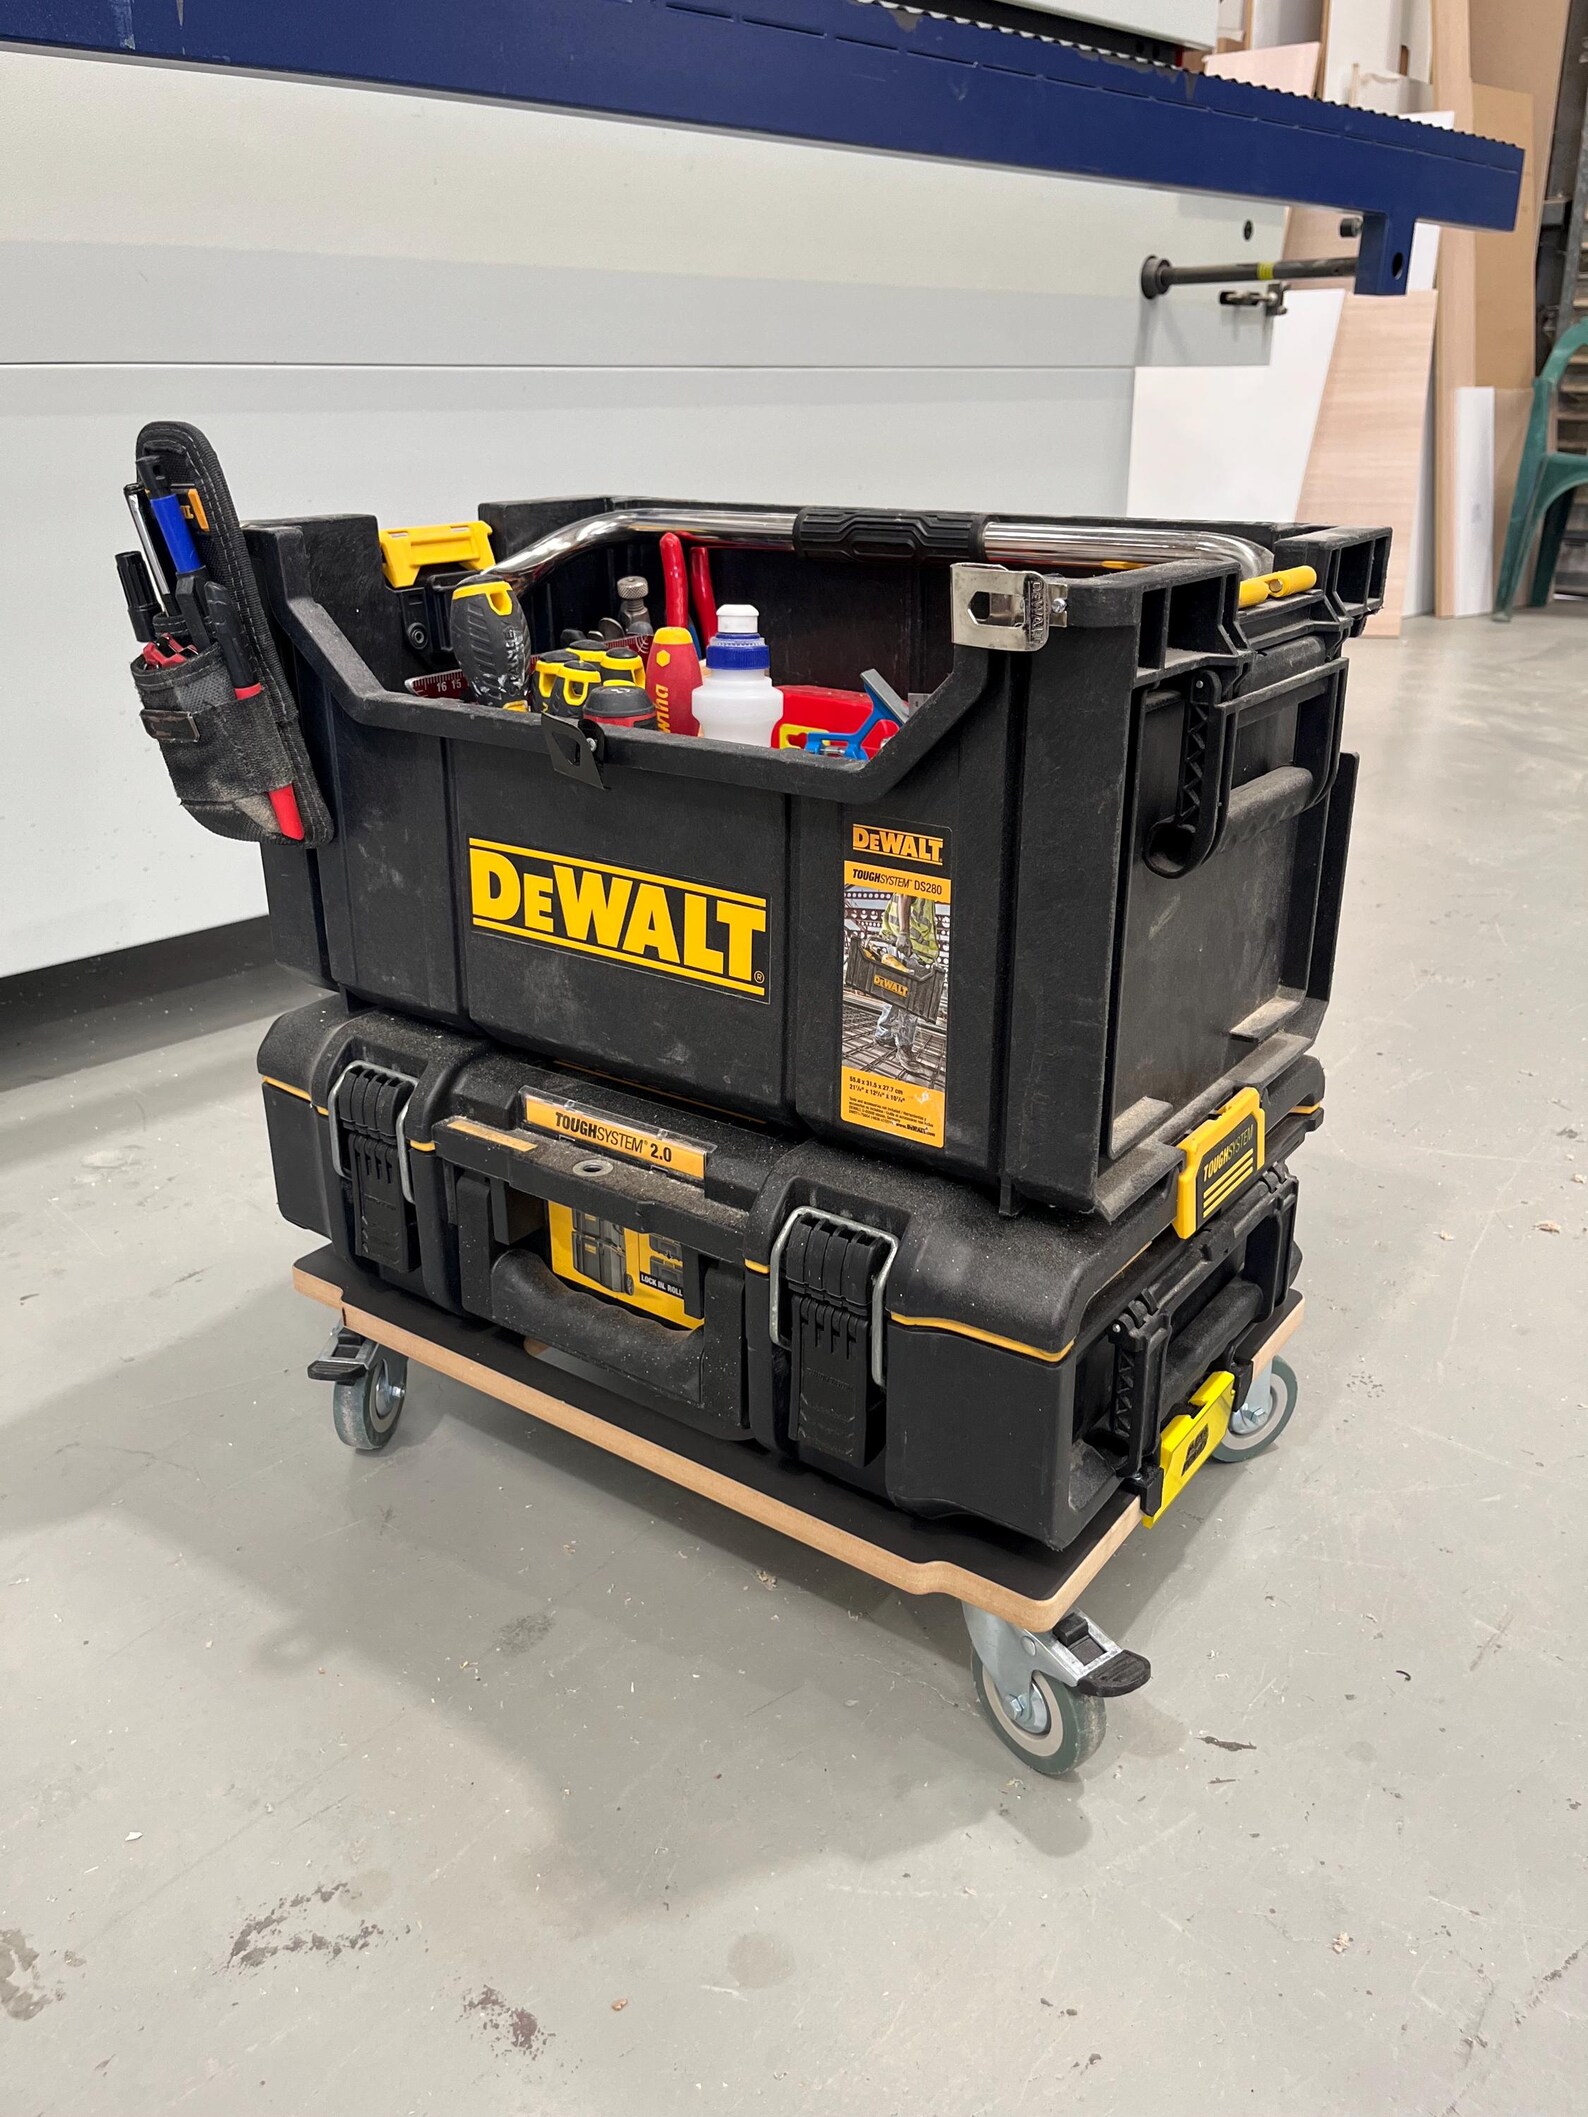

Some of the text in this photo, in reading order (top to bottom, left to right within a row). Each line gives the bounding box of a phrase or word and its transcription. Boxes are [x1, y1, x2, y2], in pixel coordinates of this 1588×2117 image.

[436, 679, 462, 692] 16 15
[853, 826, 944, 863] DEWALT
[852, 868, 943, 896] TOUGHSYSTEM DS280
[469, 847, 767, 983] DEWALT
[882, 1085, 895, 1093] 27.7
[555, 1111, 672, 1163] TOUGHSYSTEM 2.0
[1202, 1123, 1254, 1183] TOUGHSYSTEM
[640, 1273, 657, 1286] LOCK
[667, 1284, 683, 1297] ROLL
